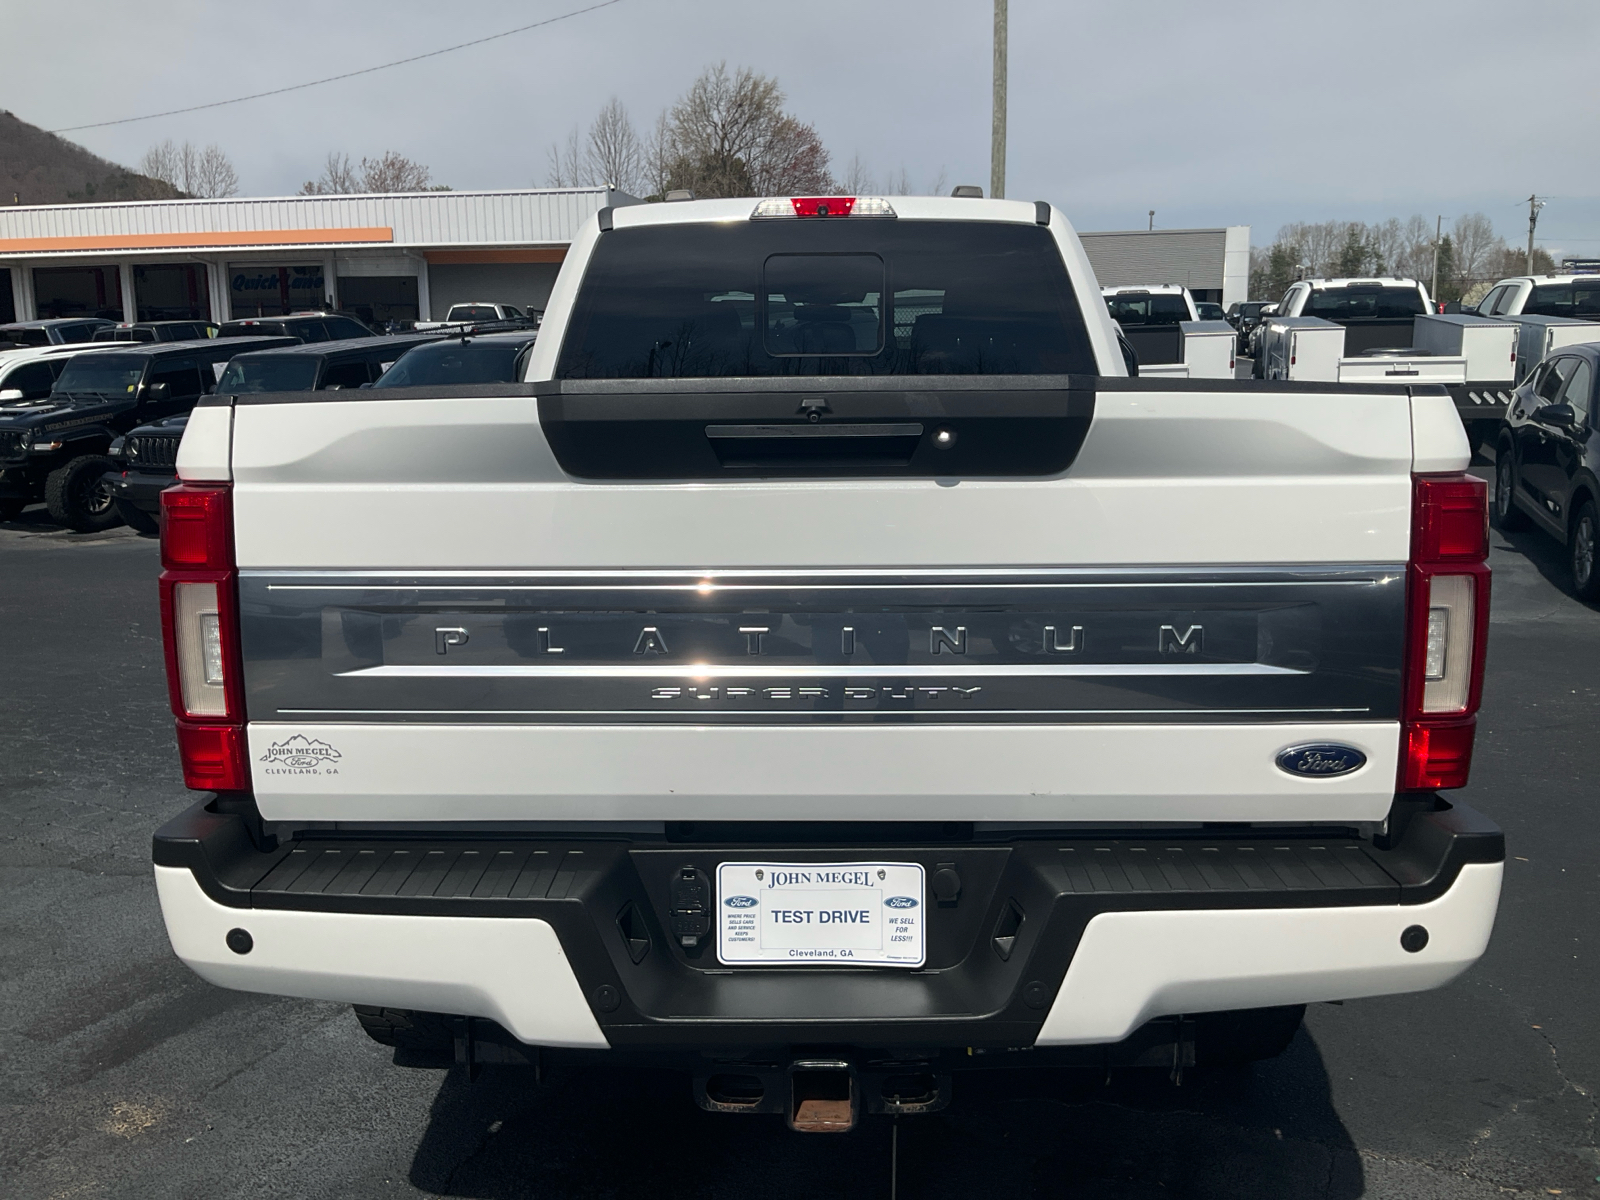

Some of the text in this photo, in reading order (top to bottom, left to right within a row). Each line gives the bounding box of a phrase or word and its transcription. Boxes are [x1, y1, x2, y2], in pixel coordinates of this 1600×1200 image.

[232, 274, 280, 292] Quick
[435, 625, 1204, 655] PLATINUM
[651, 685, 982, 700] SUPER DUTY
[267, 748, 332, 758] JOHN MEGEL
[1297, 750, 1348, 771] Ford
[290, 757, 313, 766] Ford
[768, 871, 875, 889] JOHN MEGEL
[771, 910, 870, 924] TEST DRIVE
[788, 949, 854, 958] Cleveland, GA
